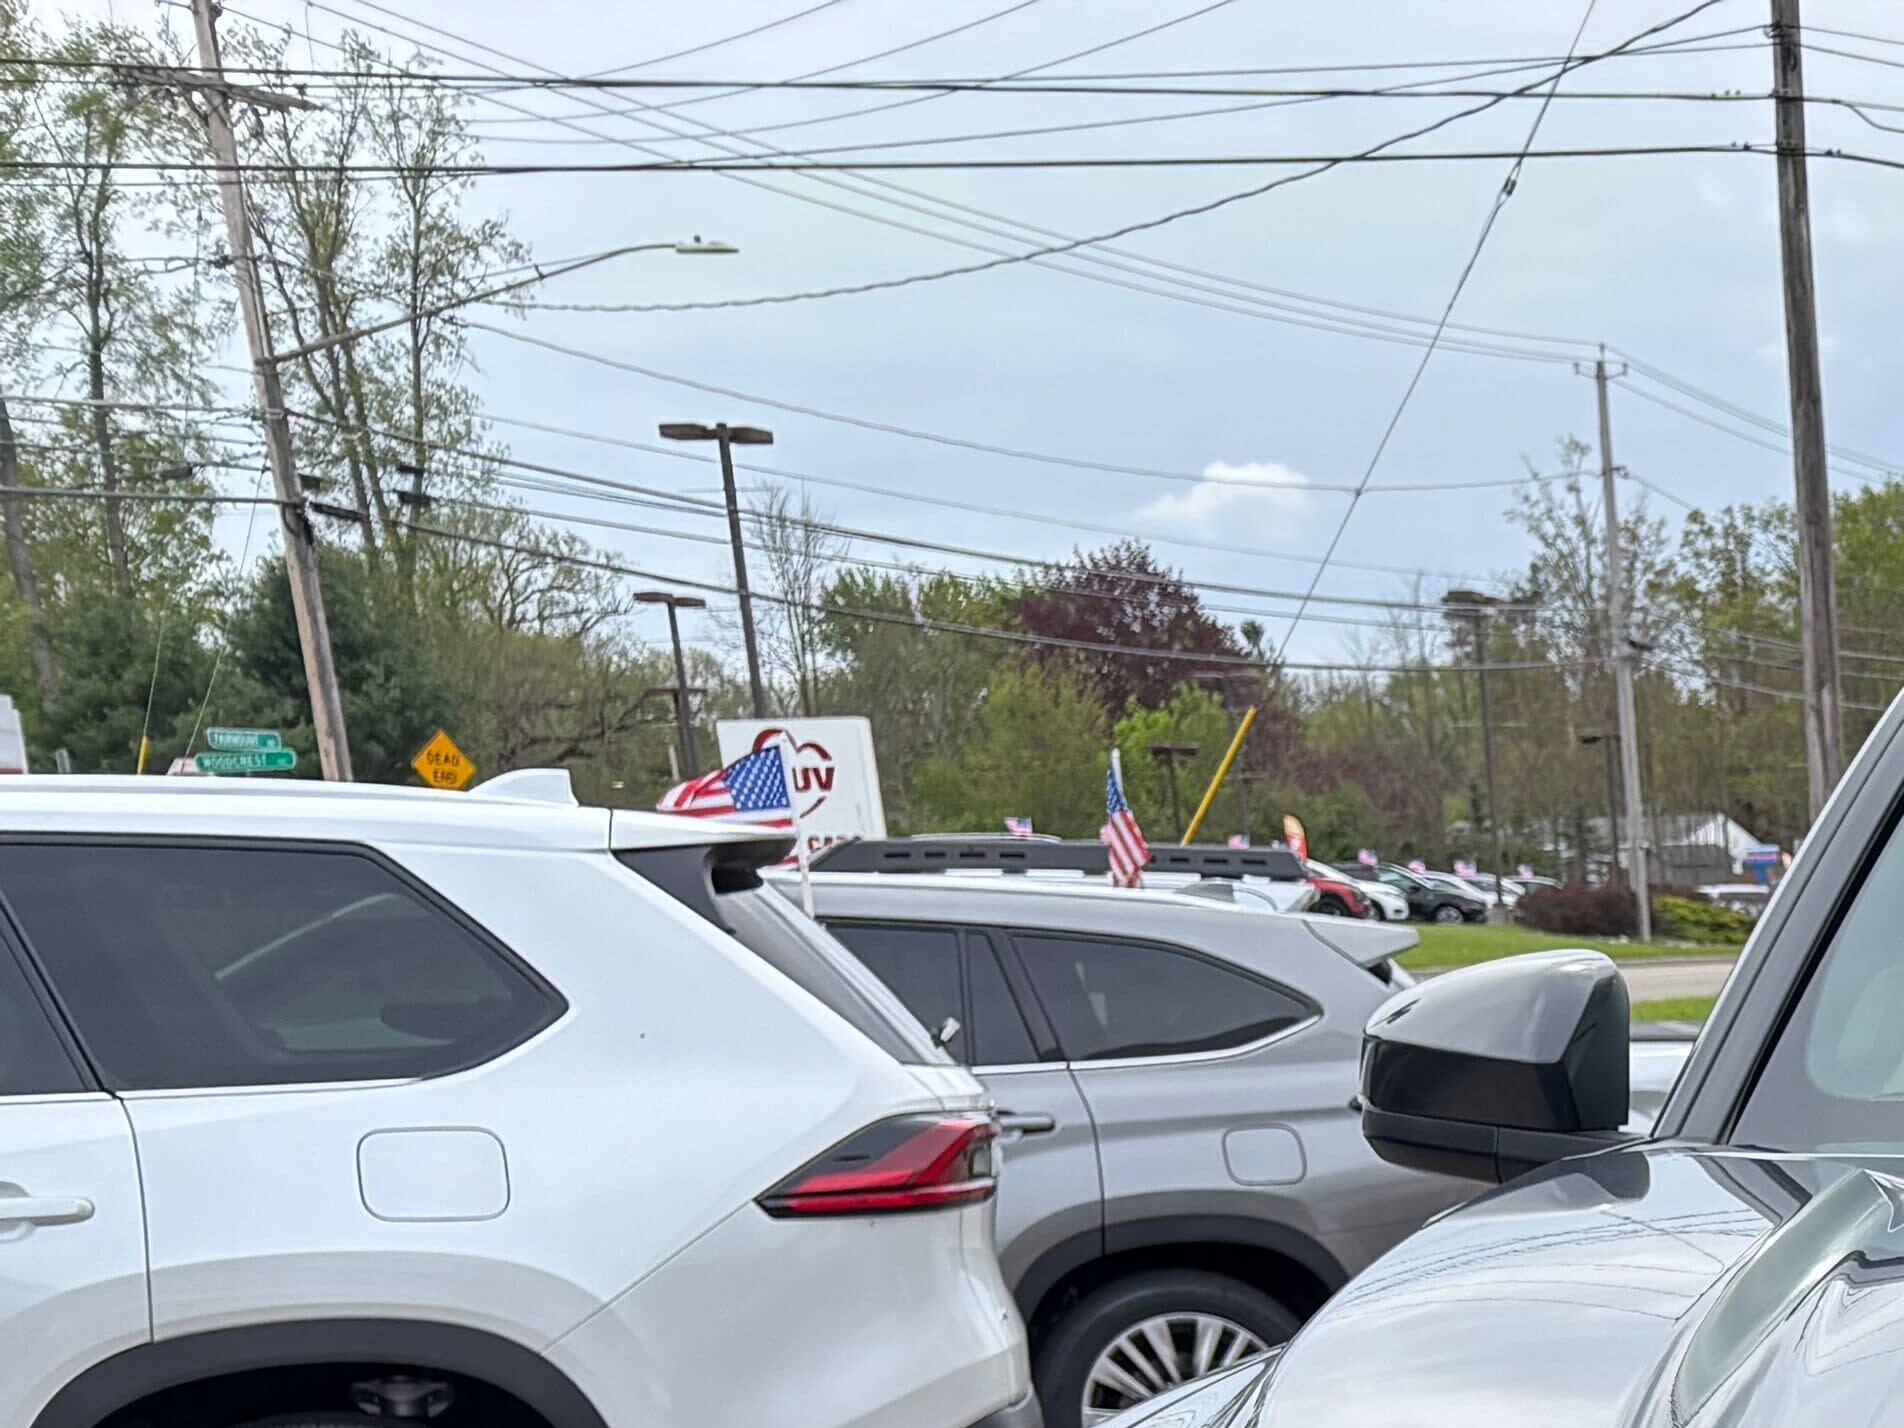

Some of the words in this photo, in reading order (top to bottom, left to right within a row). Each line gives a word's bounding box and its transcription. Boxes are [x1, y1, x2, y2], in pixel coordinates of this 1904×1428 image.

[426, 749, 459, 767] DEAD
[433, 769, 457, 785] END
[791, 766, 835, 793] UV
